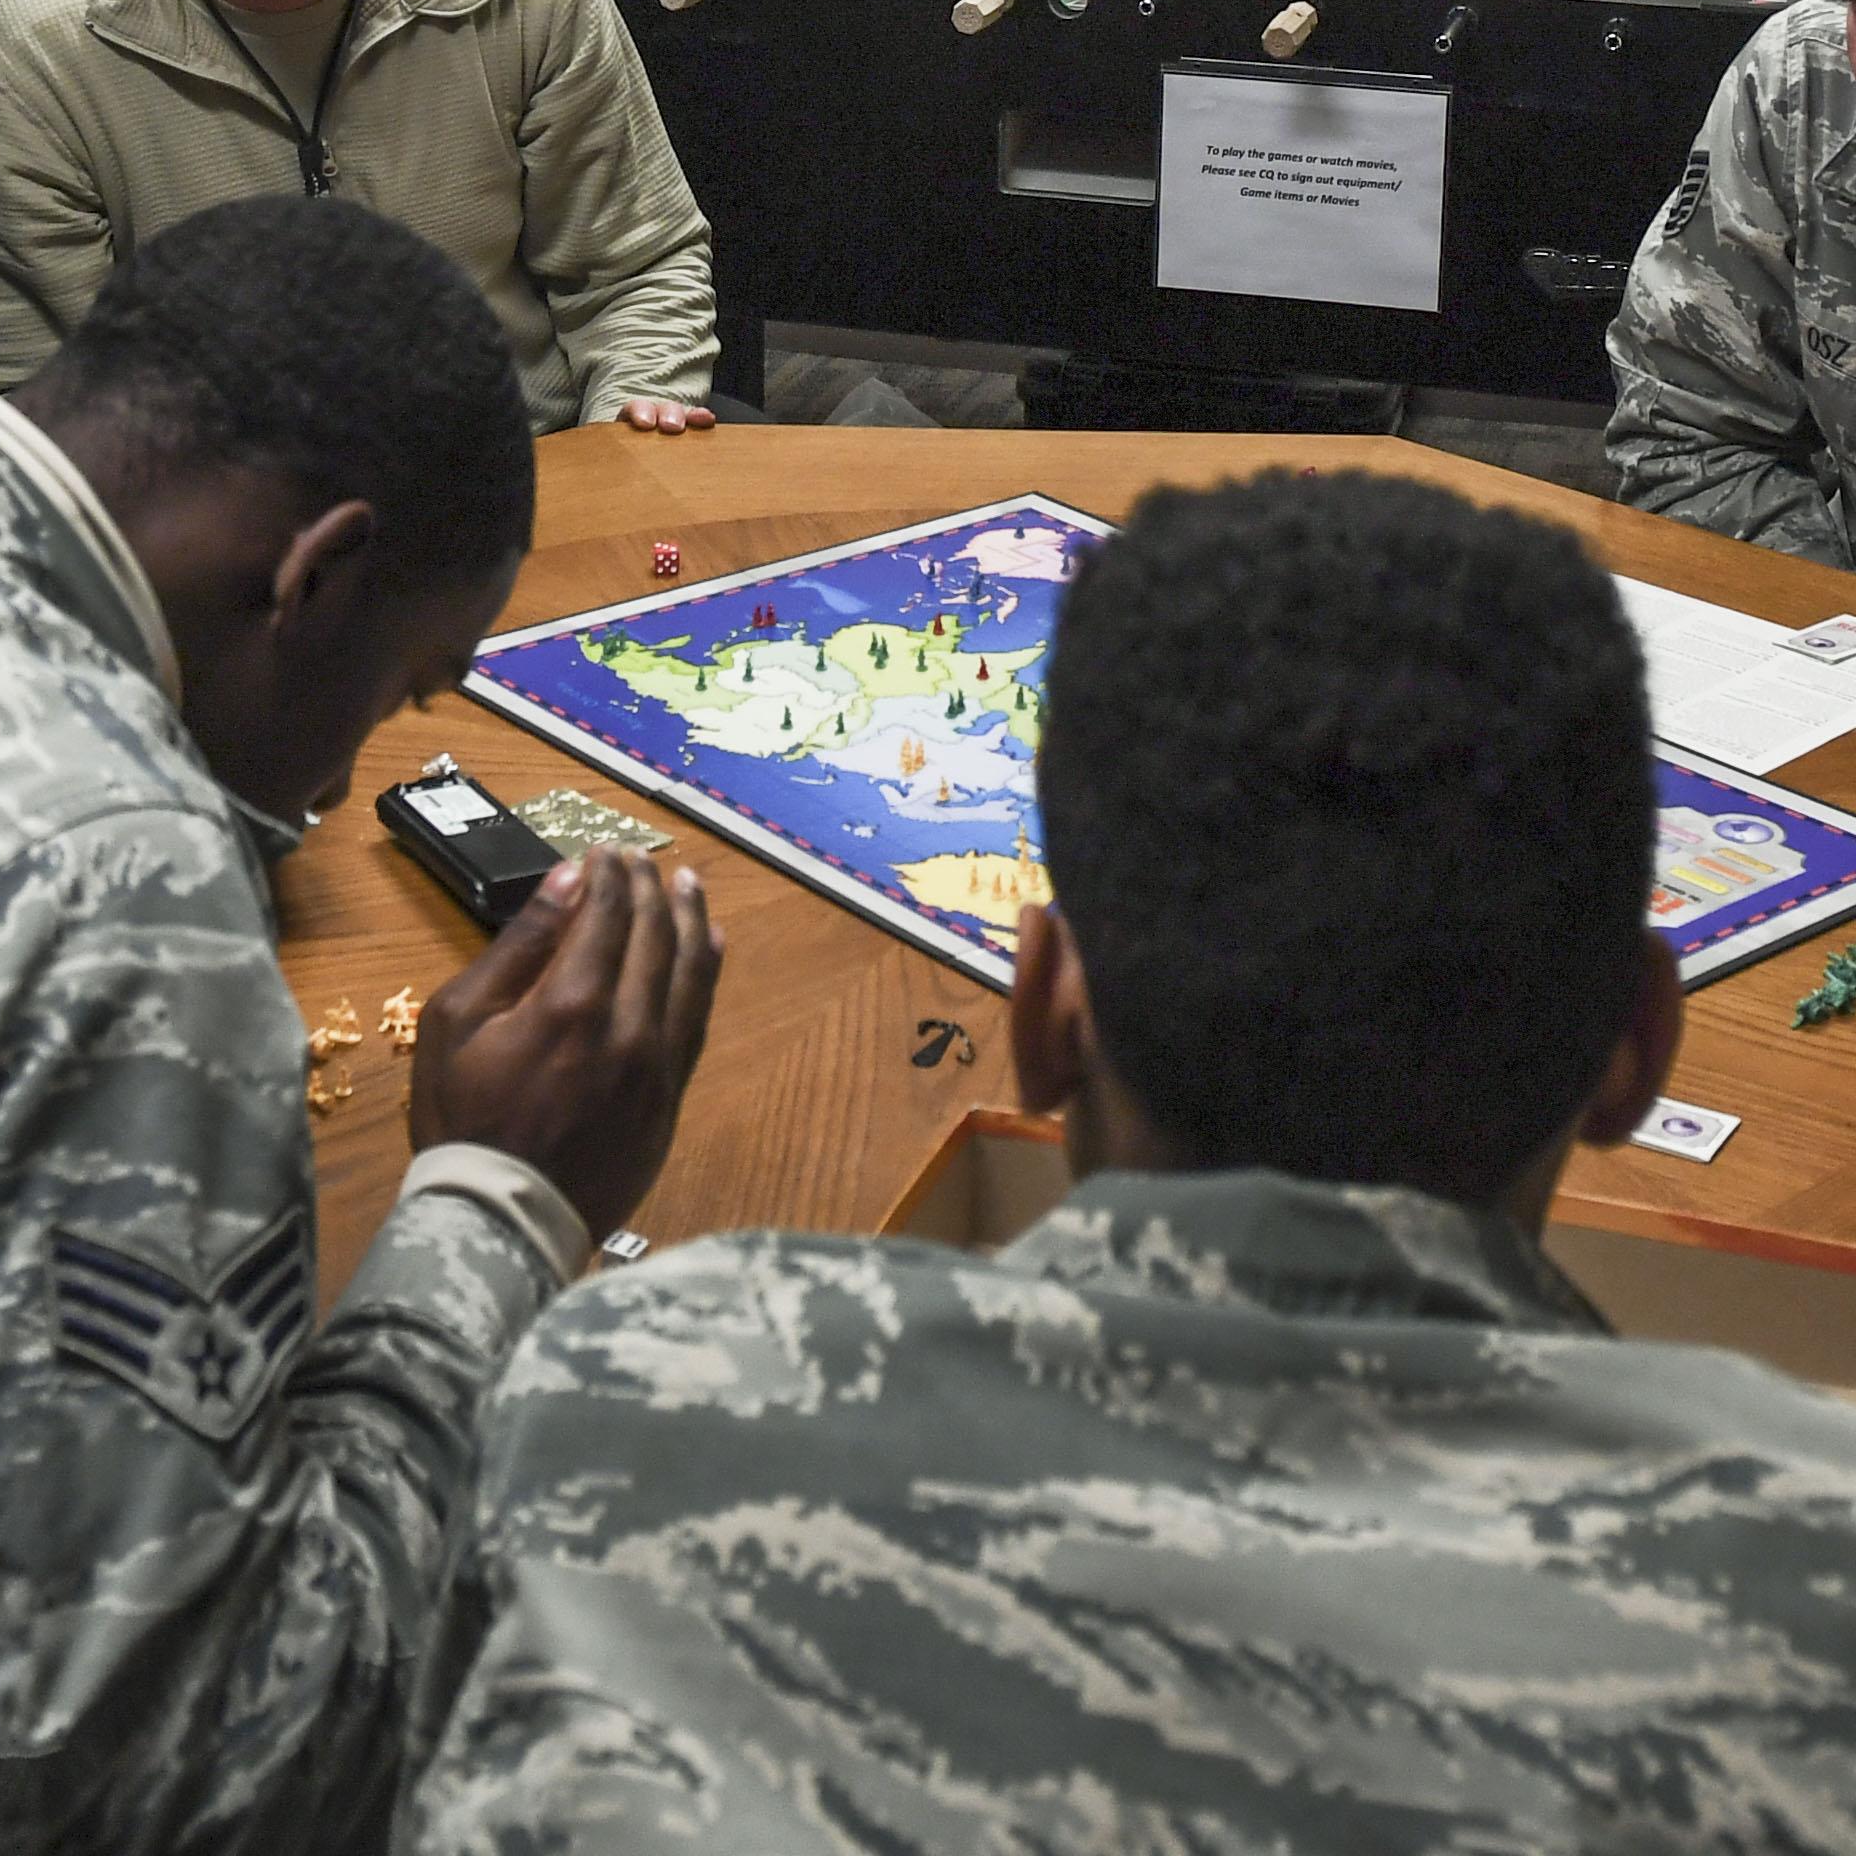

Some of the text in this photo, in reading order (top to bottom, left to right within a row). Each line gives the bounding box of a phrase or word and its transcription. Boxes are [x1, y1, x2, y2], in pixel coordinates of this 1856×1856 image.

[1207, 145, 1398, 173] To play the games or watch movies,
[1201, 164, 1403, 192] Please see CQ to sign out equipment/
[1240, 186, 1360, 207] Game items or Movies
